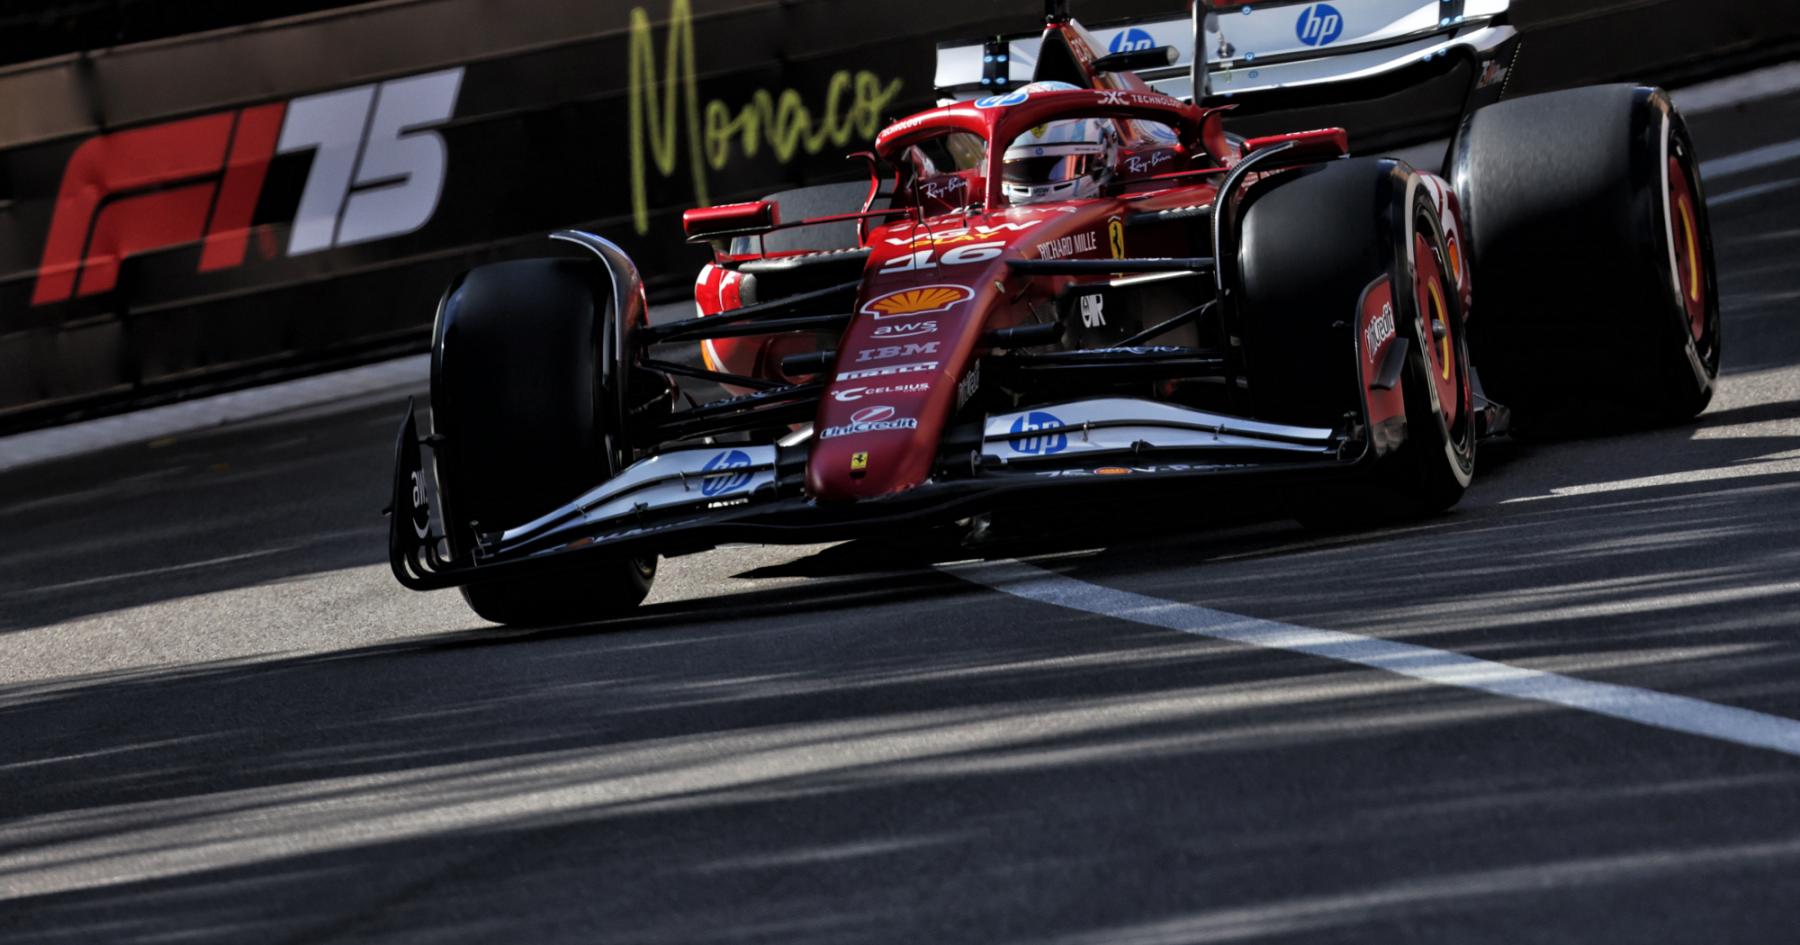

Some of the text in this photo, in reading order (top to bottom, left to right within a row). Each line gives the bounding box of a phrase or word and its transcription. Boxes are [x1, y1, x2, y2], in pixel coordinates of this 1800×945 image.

[1302, 4, 1338, 46] hp
[1094, 90, 1130, 106] DXC
[628, 0, 904, 235] Monaco
[1123, 151, 1172, 174] Ray-Ban
[919, 177, 968, 198] Ray-Ban
[885, 222, 1042, 246] VGW
[1037, 231, 1097, 261] RICHARD MILLE
[879, 241, 1006, 274] 16
[873, 320, 938, 336] aws
[855, 341, 941, 363] IBM
[836, 361, 939, 382] PIRELLI
[865, 382, 930, 396] CELSIUS
[820, 417, 917, 439] UniCredit
[1018, 411, 1060, 455] hp
